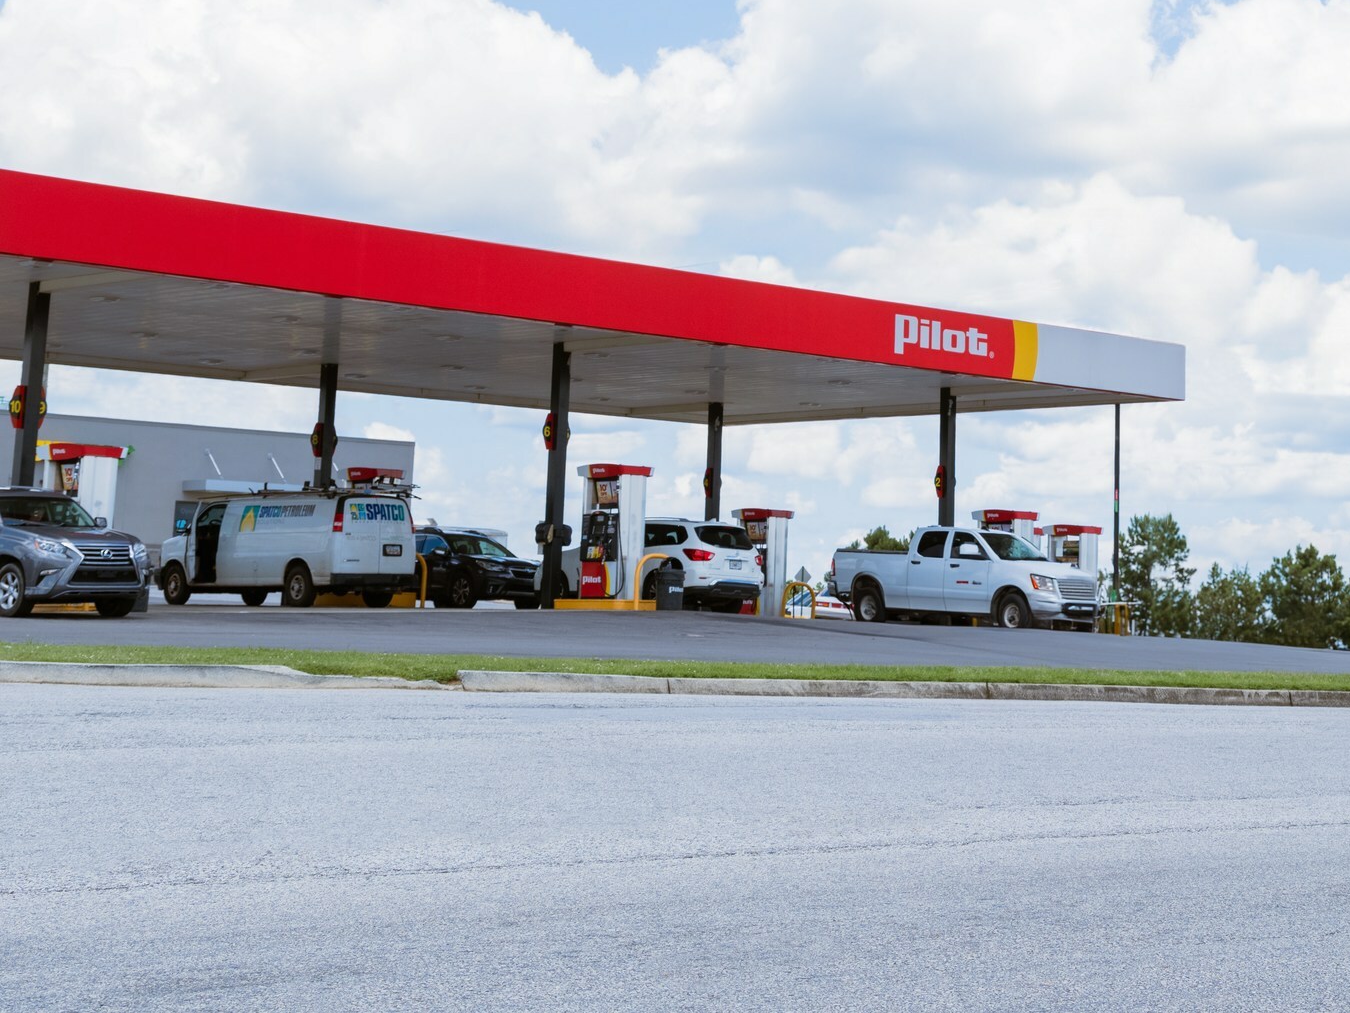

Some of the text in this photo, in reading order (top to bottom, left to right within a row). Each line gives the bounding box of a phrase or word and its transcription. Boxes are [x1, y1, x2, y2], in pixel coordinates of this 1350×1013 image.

[893, 313, 989, 357] Pilot
[10, 399, 21, 414] 10
[543, 425, 551, 437] 6
[935, 477, 941, 487] 2
[365, 503, 405, 522] SPATCO
[582, 575, 602, 585] Pilot
